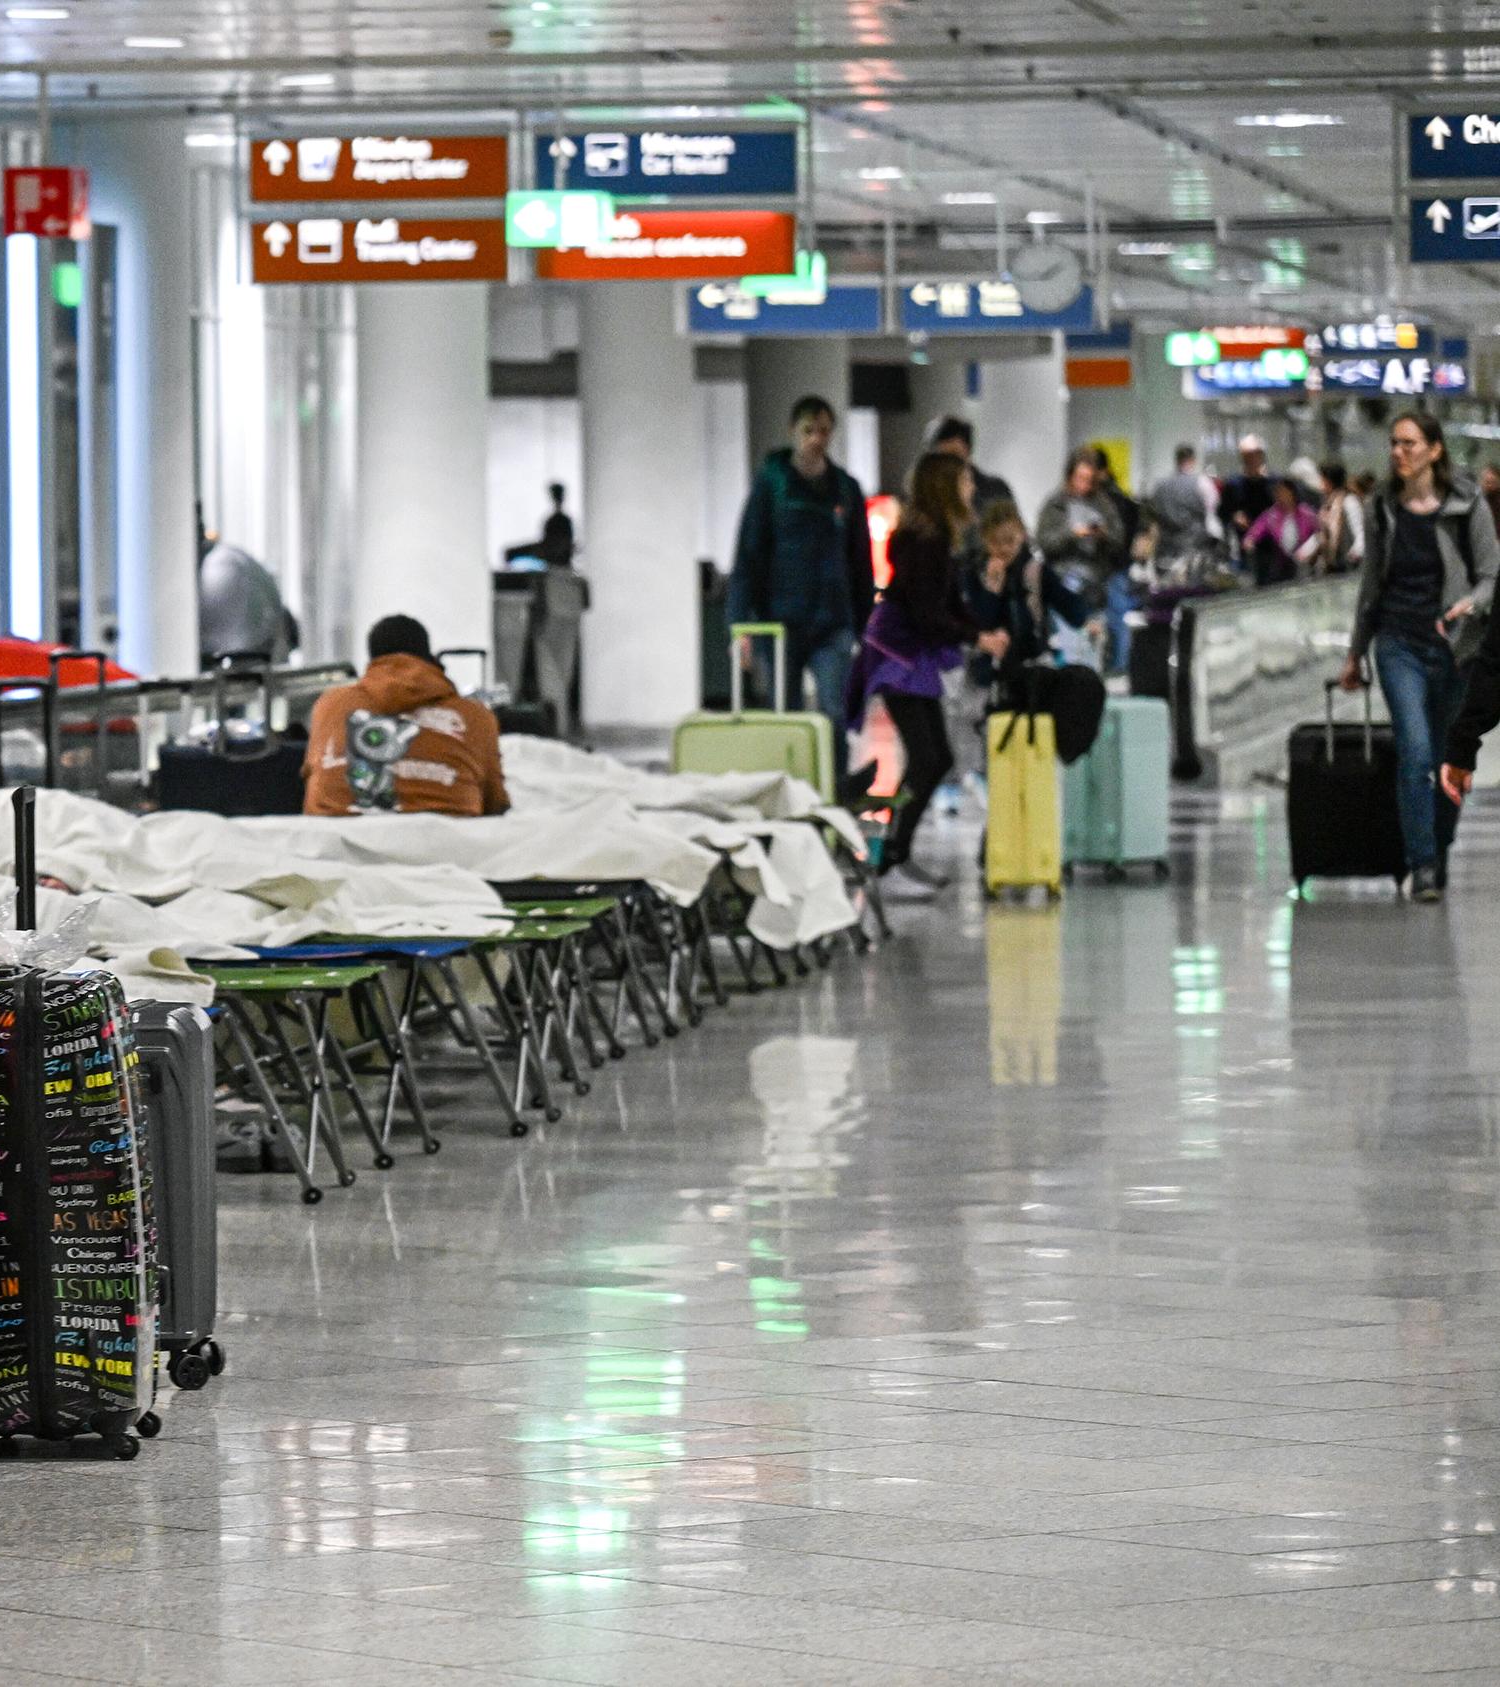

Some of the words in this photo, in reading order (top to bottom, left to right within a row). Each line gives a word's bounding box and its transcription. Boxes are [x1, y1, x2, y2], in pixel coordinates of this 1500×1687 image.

[1463, 114, 1500, 144] Ch
[43, 1036, 99, 1059] LORIDA
[44, 1079, 73, 1095] EW
[85, 1071, 114, 1089] ORK
[45, 1108, 73, 1119] ofia
[55, 1199, 98, 1209] Sydney
[50, 1235, 123, 1244] Vancouver
[66, 1247, 117, 1260] Chicago
[52, 1278, 137, 1300] ISTANBU
[60, 1301, 122, 1316] Prague
[95, 1357, 133, 1377] YORK
